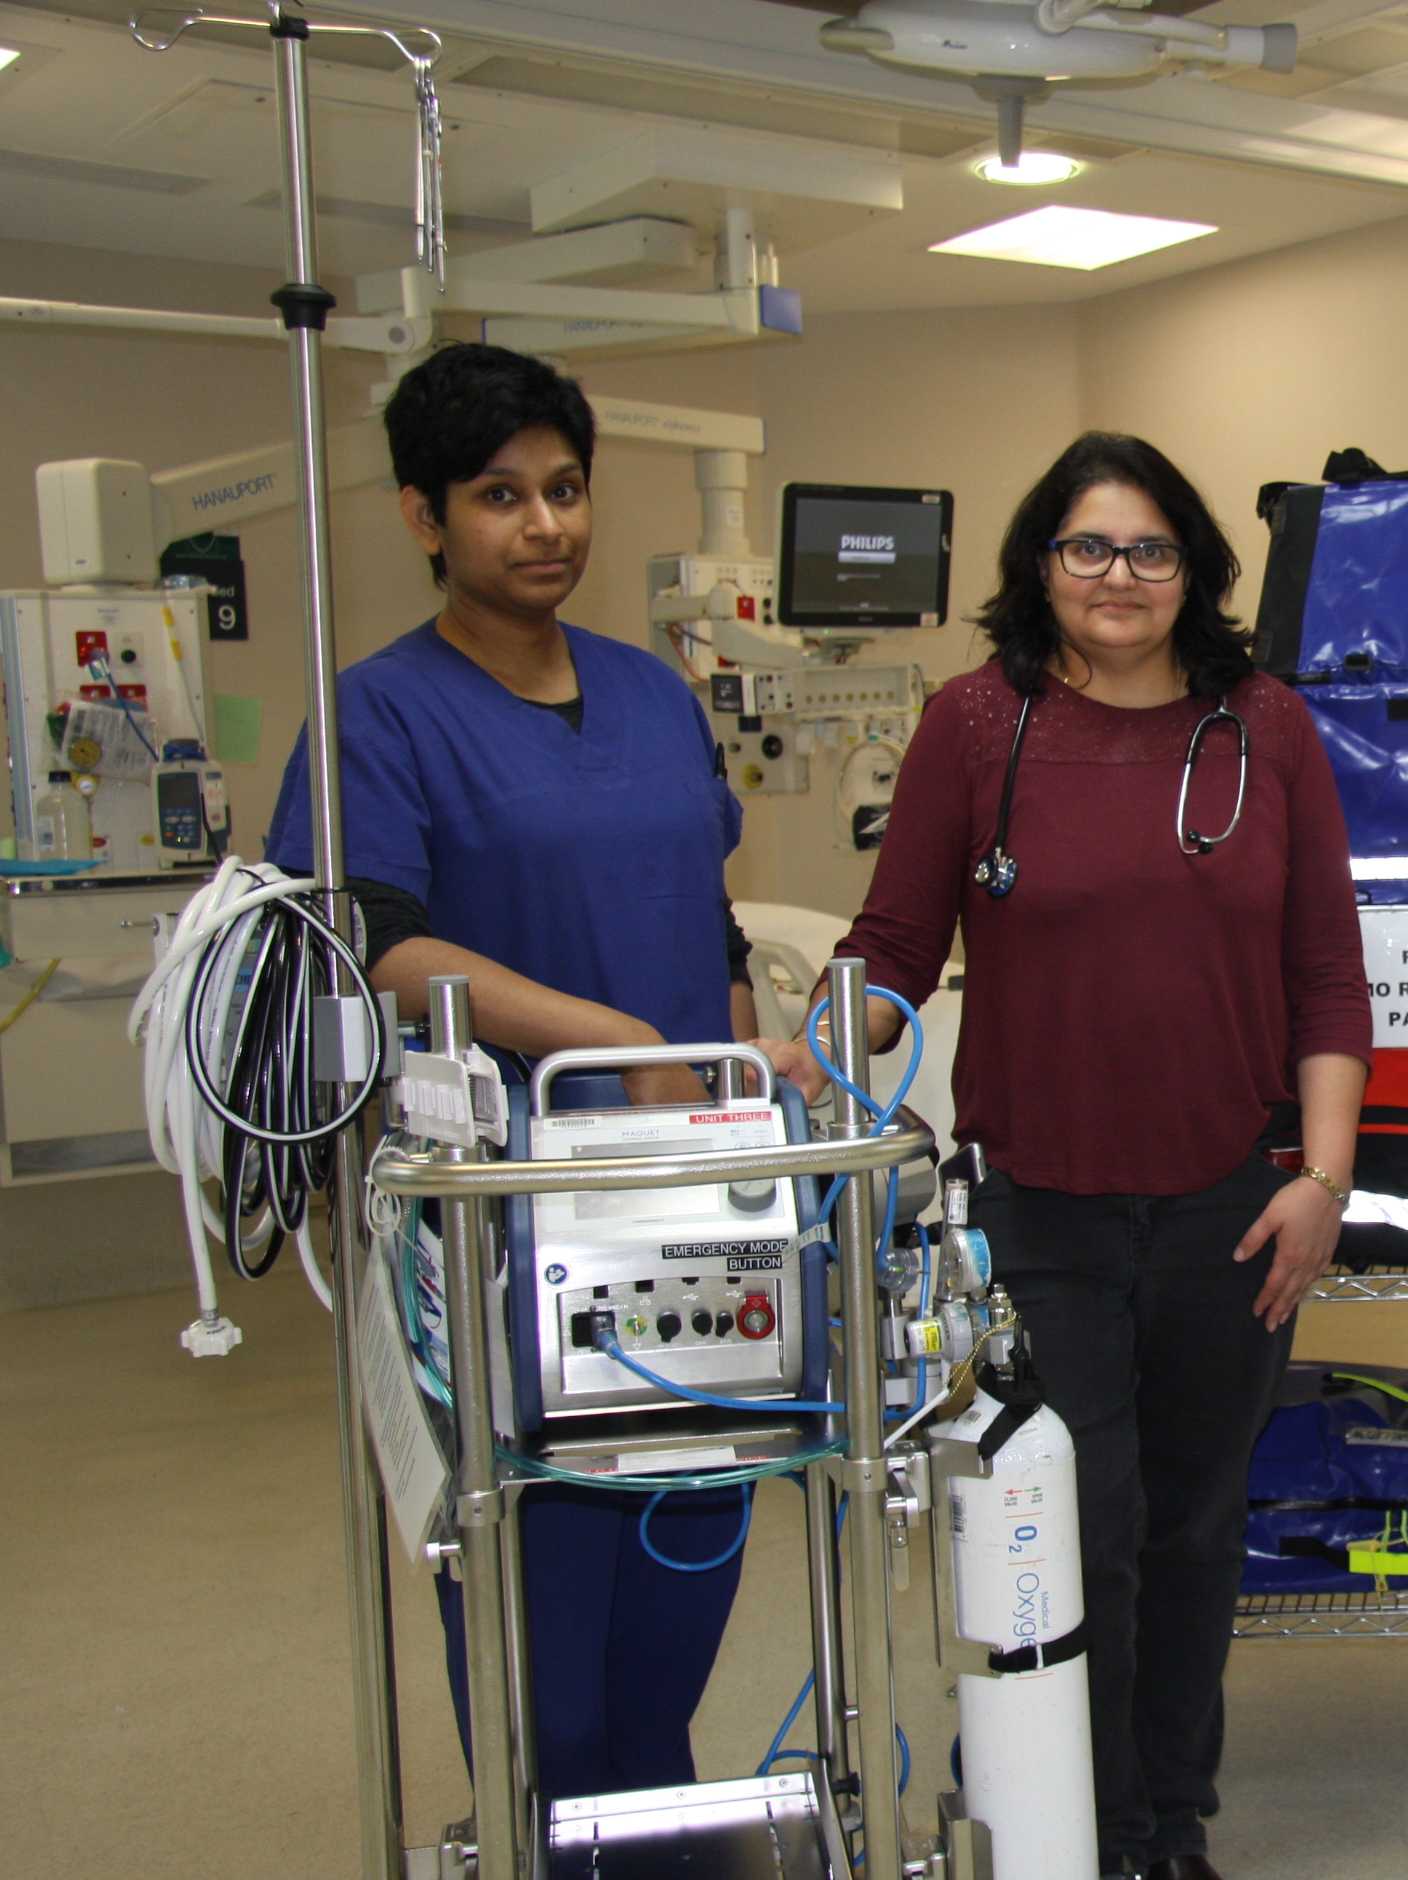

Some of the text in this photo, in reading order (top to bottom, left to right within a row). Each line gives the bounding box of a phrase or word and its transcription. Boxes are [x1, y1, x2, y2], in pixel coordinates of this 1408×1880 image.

[191, 474, 275, 511] HANAUPORT
[841, 534, 895, 550] PHILIPS
[218, 605, 236, 630] 9
[695, 1111, 770, 1123] UNIT THREE
[665, 1240, 787, 1258] EMERGENCY MODE
[730, 1258, 781, 1270] BUTTON
[1012, 1572, 1040, 1648] Oxyge
[1041, 1590, 1050, 1629] Medical
